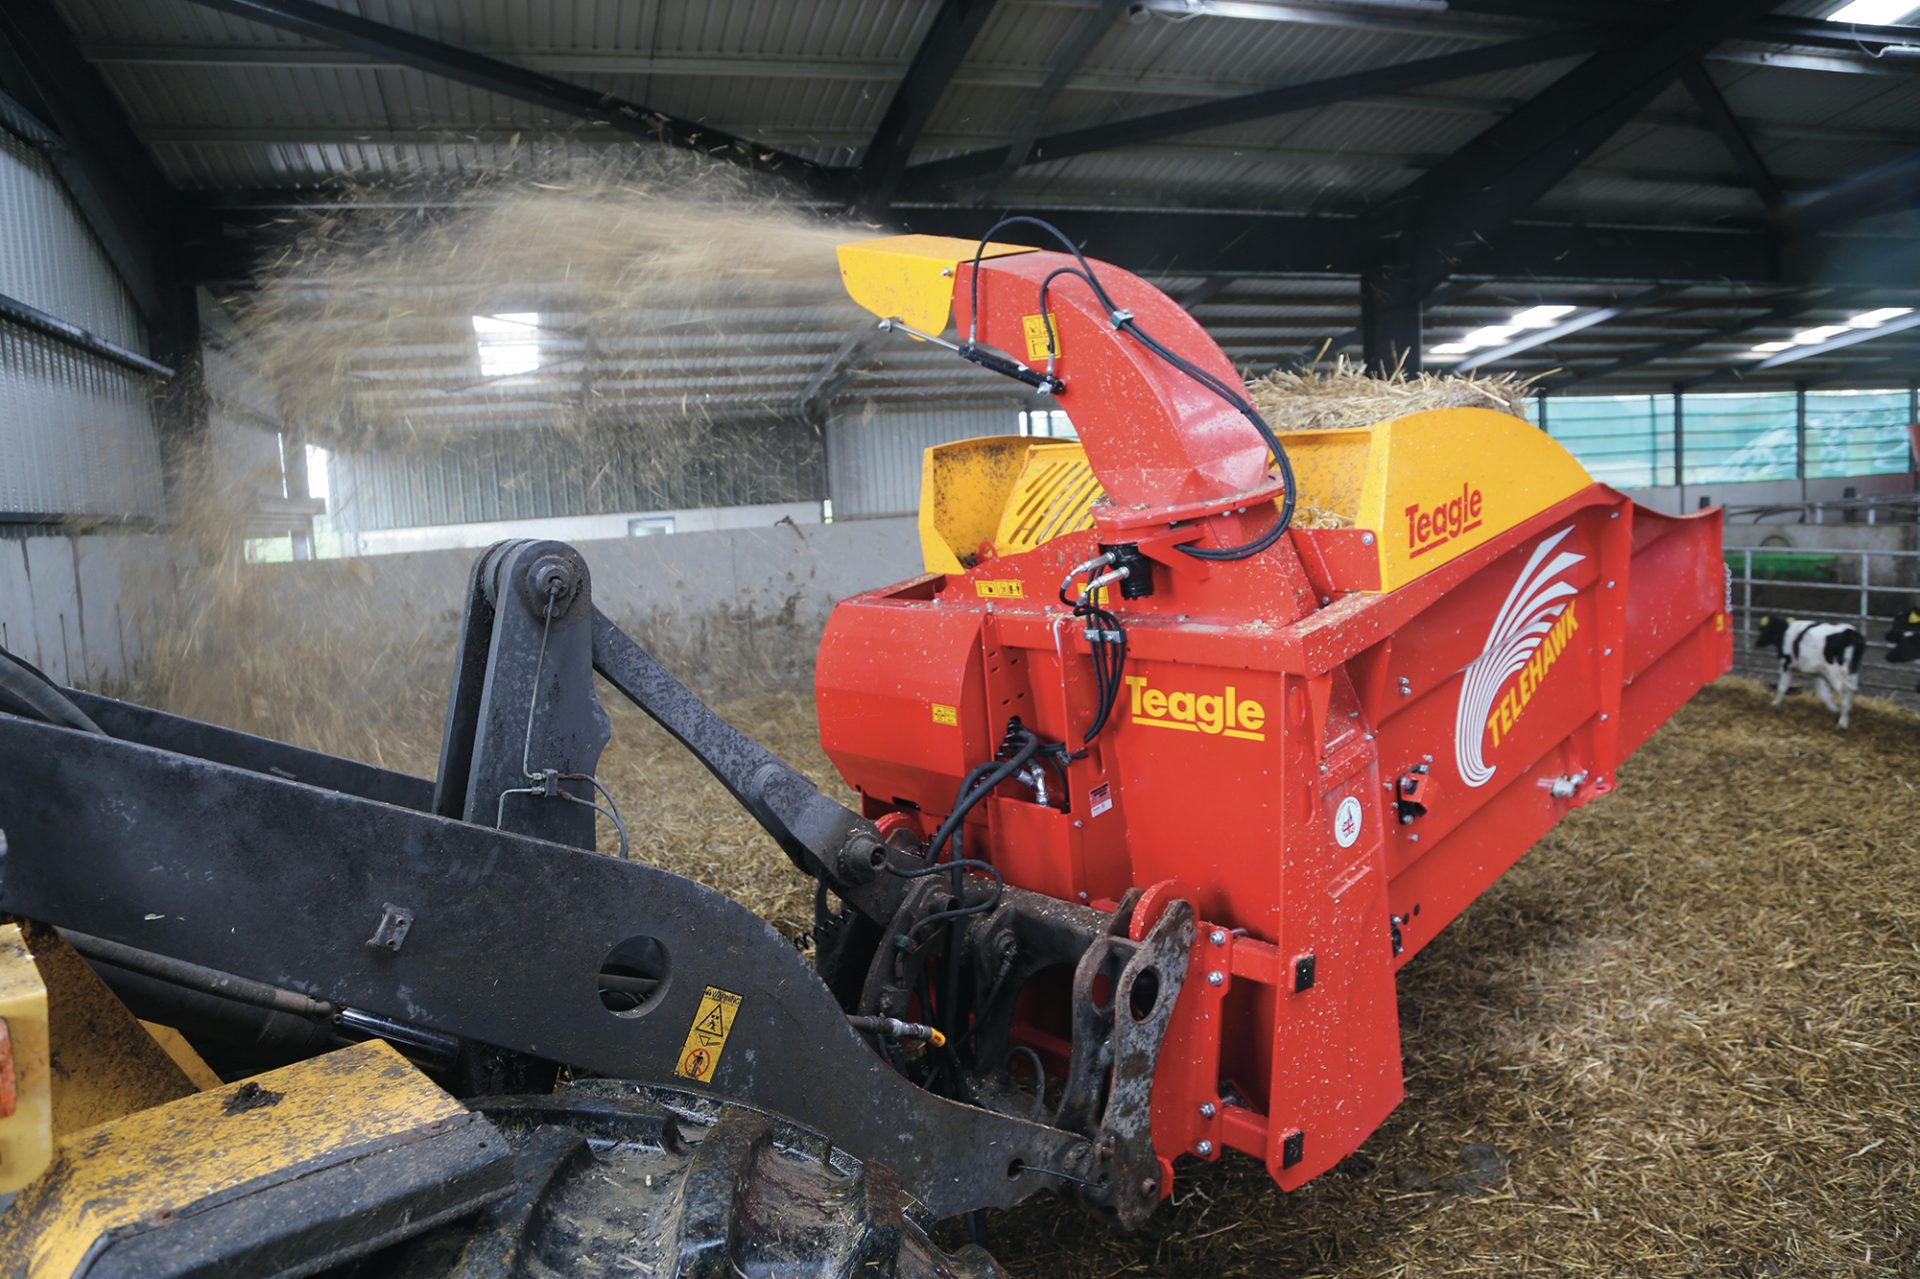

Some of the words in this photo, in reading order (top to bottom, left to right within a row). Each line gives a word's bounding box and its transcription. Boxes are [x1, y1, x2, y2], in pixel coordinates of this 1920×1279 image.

[1405, 481, 1482, 549] Teagle
[1125, 675, 1265, 735] Teagle
[1487, 598, 1579, 749] TELEHAWK
[711, 990, 741, 1004] WARNING
